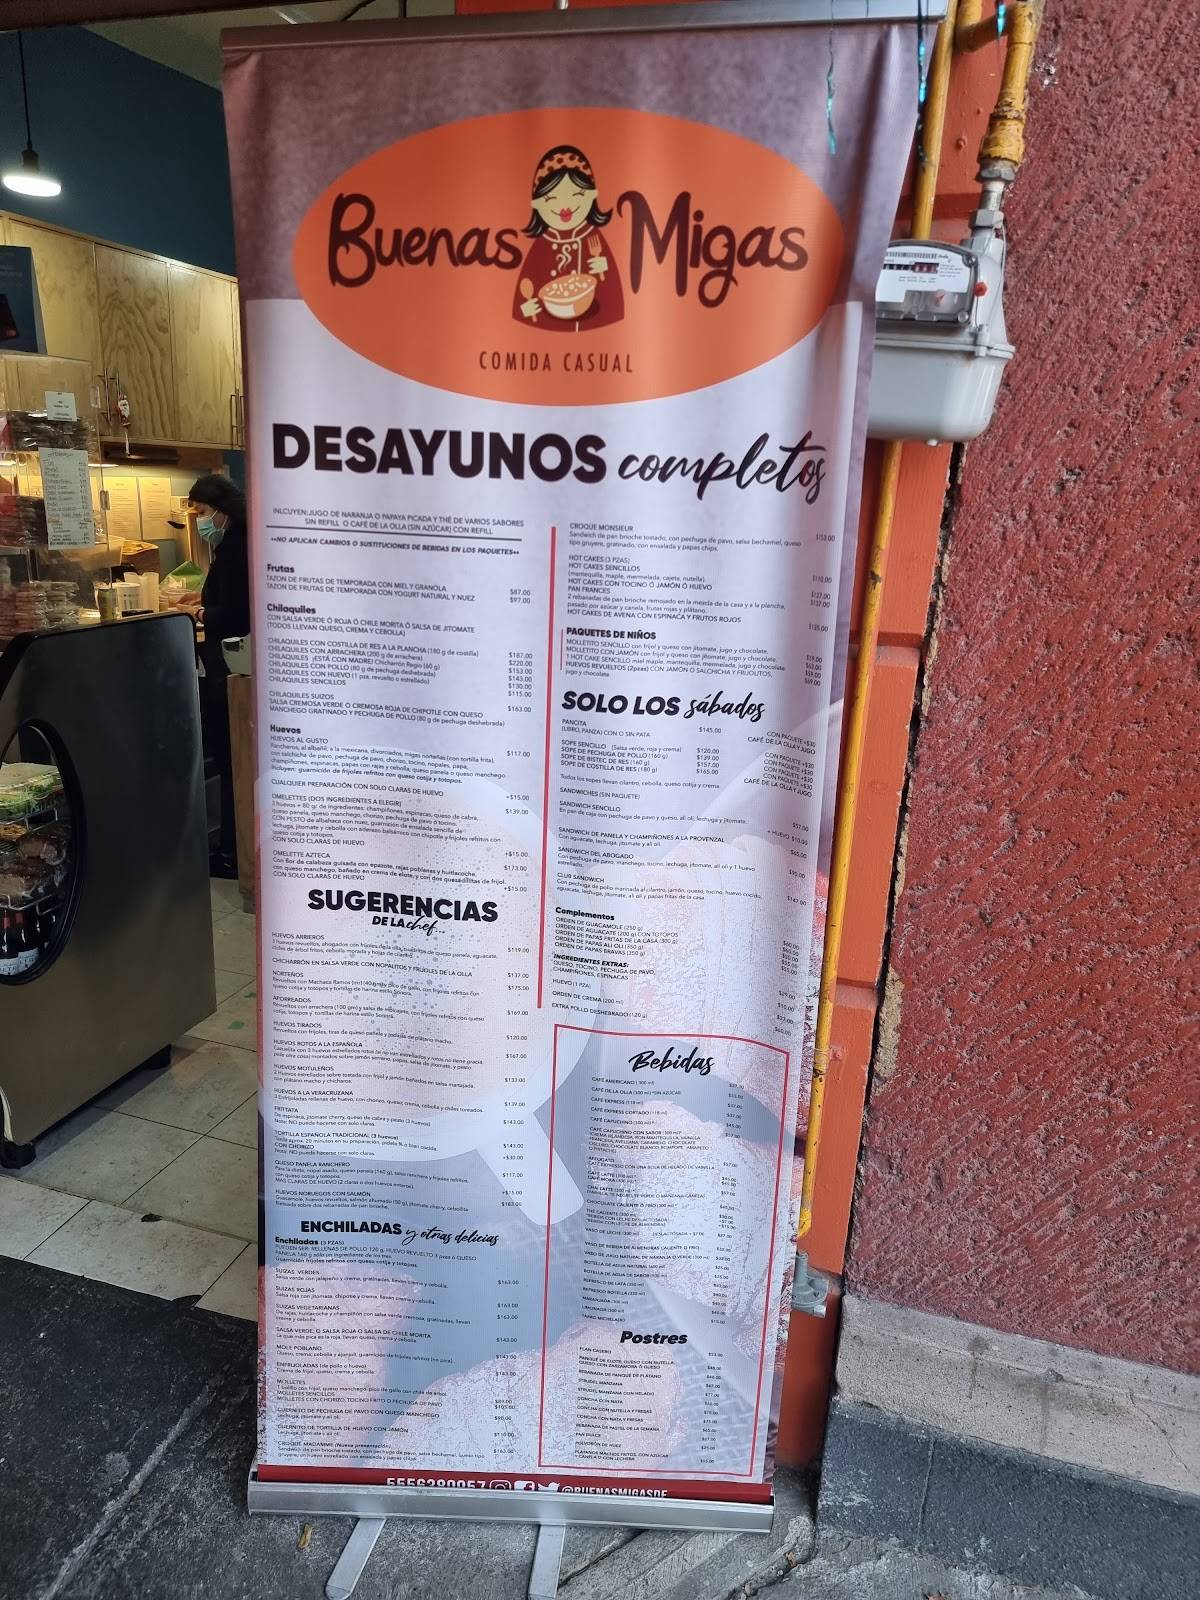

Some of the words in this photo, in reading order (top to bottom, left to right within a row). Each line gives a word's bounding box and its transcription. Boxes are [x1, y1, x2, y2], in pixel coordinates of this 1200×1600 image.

[327, 192, 523, 288] Buenas
[616, 190, 808, 308] Migas
[479, 351, 552, 372] COMIDA
[564, 352, 634, 374] CASUAL
[272, 423, 606, 484] DESAYUNOS
[617, 430, 826, 504] completos
[341, 511, 373, 520] NARANJA
[382, 513, 406, 521] PAPAYA
[407, 514, 432, 523] PICADA
[439, 514, 452, 524] THÉ
[464, 517, 490, 526] VARIOS
[492, 518, 524, 527] SABORES
[318, 519, 339, 527] REFILL
[350, 519, 368, 528] CAFÉ
[389, 522, 406, 530] OLLA
[407, 522, 421, 532] (SIN
[422, 522, 452, 534] AZÚCAR)
[453, 526, 470, 534] CON
[471, 527, 492, 535] REFILL
[570, 522, 597, 531] CROQUE
[598, 524, 633, 532] MONSIEUR
[288, 536, 318, 545] APLICAN
[320, 538, 351, 547] CAMBIOS
[360, 540, 410, 550] SUSTITUCIONES
[422, 544, 450, 552] BEBIDAS
[266, 564, 295, 573] Frutas
[266, 575, 287, 583] TAZON
[298, 576, 324, 585] FRUTAS
[336, 578, 376, 588] TEMPORADA
[378, 581, 393, 589] CON
[394, 582, 408, 590] MIEL
[414, 583, 446, 592] GRANOLA
[266, 582, 287, 591] TAZON
[299, 584, 324, 593] FRUTAS
[336, 586, 377, 596] TEMPORADA
[378, 589, 393, 597] CON
[394, 590, 419, 598] YOGURT
[421, 591, 450, 600] NATURAL
[457, 594, 475, 602] NUEZ
[267, 604, 316, 616] Chilaquiles
[582, 609, 602, 617] CAKES
[613, 610, 636, 619] AVENA
[654, 612, 685, 621] ESPINACA
[692, 614, 718, 622] FRUTOS
[719, 615, 741, 623] ROJOS
[266, 614, 281, 622] CON
[282, 615, 302, 623] SALSA
[304, 616, 325, 624] VERDE
[334, 618, 352, 626] ROJA
[360, 619, 378, 627] CHILE
[380, 620, 404, 629] MORITA
[412, 622, 431, 630] SALSA
[443, 624, 475, 633] JITOMATE
[566, 627, 611, 638] PAQUETES
[613, 630, 625, 639] DE
[627, 629, 656, 639] NIÑOS
[268, 674, 309, 685] CHILAQUILES
[310, 678, 346, 686] SENCILLOS
[562, 690, 628, 714] SOLO
[633, 696, 680, 716] LOS
[683, 690, 765, 722] sábados
[270, 724, 301, 735] Huevos
[562, 718, 587, 727] PANCITA
[270, 734, 295, 744] HUEVOS
[271, 778, 306, 787] CUALQUIER
[307, 778, 352, 790] PREPARACIÓN
[353, 783, 368, 791] CON
[369, 784, 387, 792] SOLO
[388, 785, 411, 794] CLARAS
[422, 788, 444, 797] HUEVO
[559, 827, 590, 837] SANDWICH
[600, 830, 623, 839] PANELA
[629, 831, 674, 842] CHAMPIÑONES
[272, 849, 304, 858] OMELETTE
[305, 850, 330, 859] AZTECA
[308, 889, 498, 922] SUGERENCIAS
[556, 907, 615, 920] Complementos
[372, 916, 388, 926] DE
[390, 917, 405, 928] LA
[271, 931, 294, 940] HUEVOS
[553, 954, 600, 965] INGREDIENTES
[273, 1019, 296, 1028] HUEVOS
[628, 1046, 715, 1075] Bebidas
[300, 1220, 402, 1234] ENCHILADAS
[420, 1226, 452, 1244] otras
[454, 1230, 499, 1246] delicias
[275, 1236, 319, 1245] Enchiladas
[620, 1330, 688, 1344] Postres
